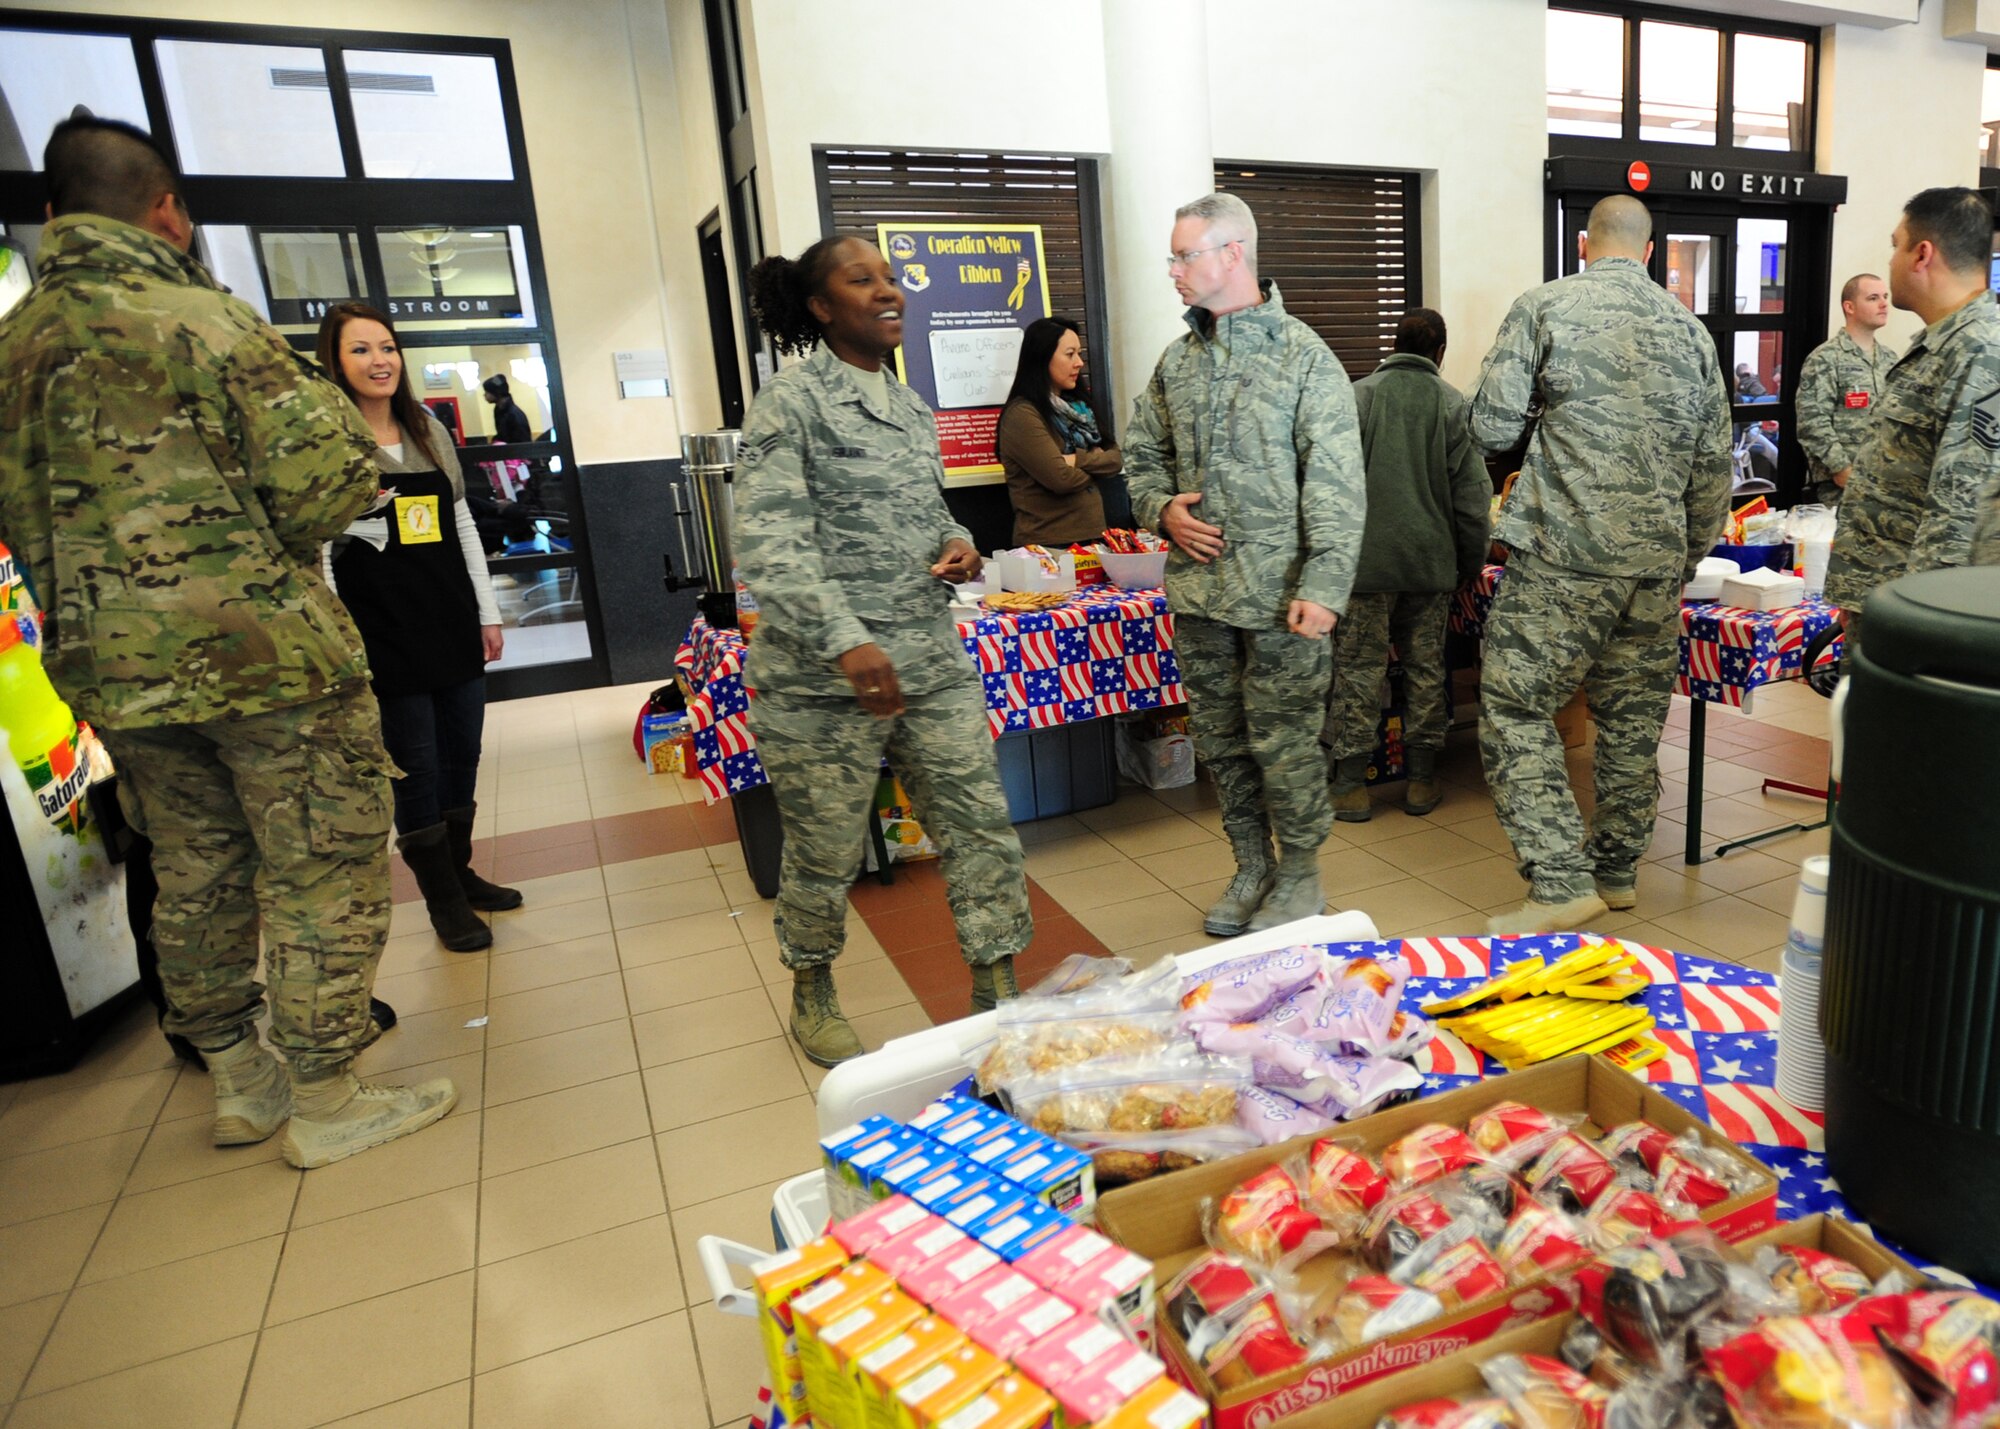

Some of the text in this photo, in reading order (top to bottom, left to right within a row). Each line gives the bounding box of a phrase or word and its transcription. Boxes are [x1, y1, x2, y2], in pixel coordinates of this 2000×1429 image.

[1690, 170, 1805, 196] NO EXIT
[927, 234, 1022, 255] Operation Yellow
[959, 264, 1002, 283] Ribbon
[389, 300, 490, 314] STROOM
